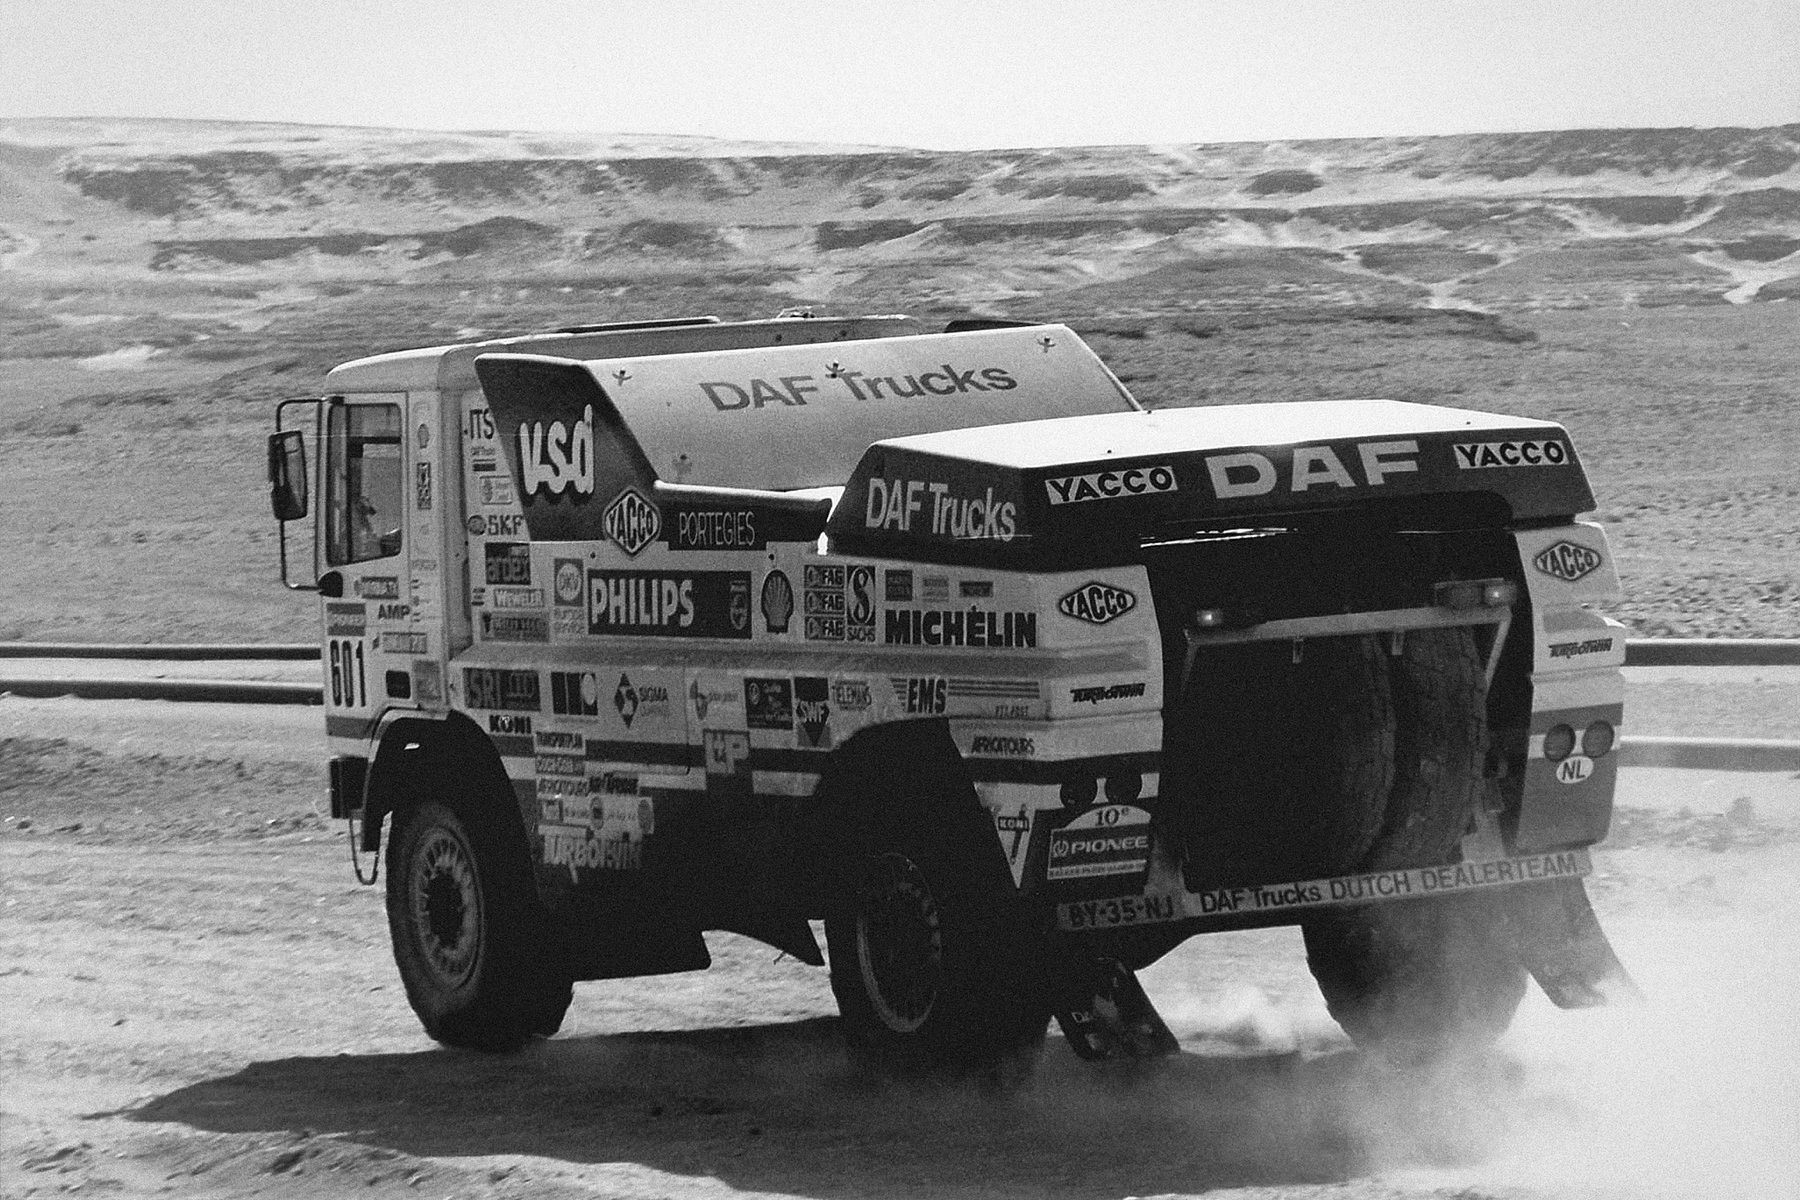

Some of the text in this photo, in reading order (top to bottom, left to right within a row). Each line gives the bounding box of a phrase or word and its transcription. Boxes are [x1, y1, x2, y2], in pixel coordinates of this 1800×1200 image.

[699, 364, 1018, 411] DAF Trucks
[1204, 439, 1420, 499] DAF
[1456, 440, 1565, 468] YACCO
[1049, 467, 1174, 502] YACCO
[487, 514, 525, 536] SKF
[607, 496, 655, 551] YACCO
[678, 511, 756, 546] PORTEGIES
[865, 477, 1017, 542] DAF Trucks
[1539, 545, 1596, 578] YACCO
[590, 577, 695, 628] PHILIPS
[1062, 584, 1129, 624] YACCO
[885, 609, 1038, 648] MICHELIN
[329, 640, 366, 708] 601
[907, 677, 948, 714] EMS
[1560, 760, 1587, 781] NL
[998, 816, 1030, 831] KONI
[1200, 889, 1246, 914] DAF
[1253, 881, 1322, 908] Trucks
[1329, 872, 1411, 901] DUTCH
